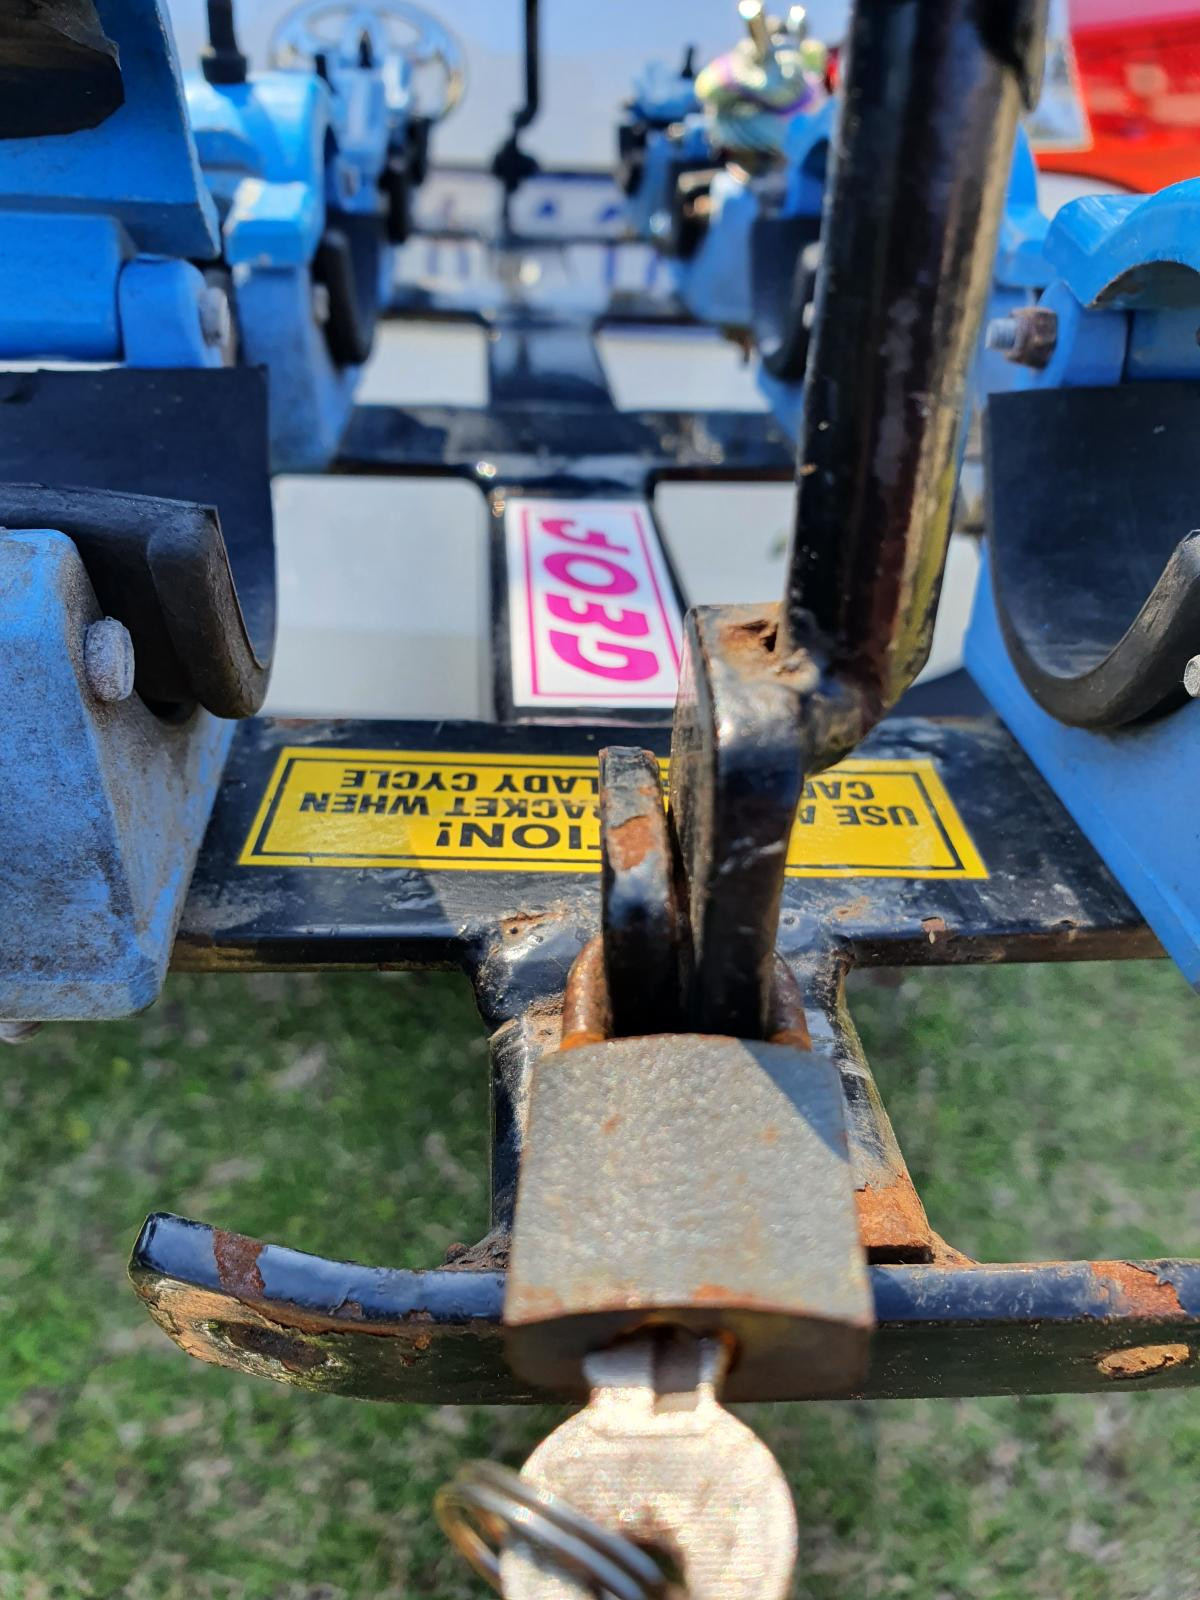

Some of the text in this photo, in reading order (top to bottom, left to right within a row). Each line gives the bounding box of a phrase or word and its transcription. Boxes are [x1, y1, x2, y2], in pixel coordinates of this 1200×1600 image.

[341, 768, 599, 794] LADY CYCLE
[299, 792, 430, 815] WHEN
[832, 804, 919, 826] USE
